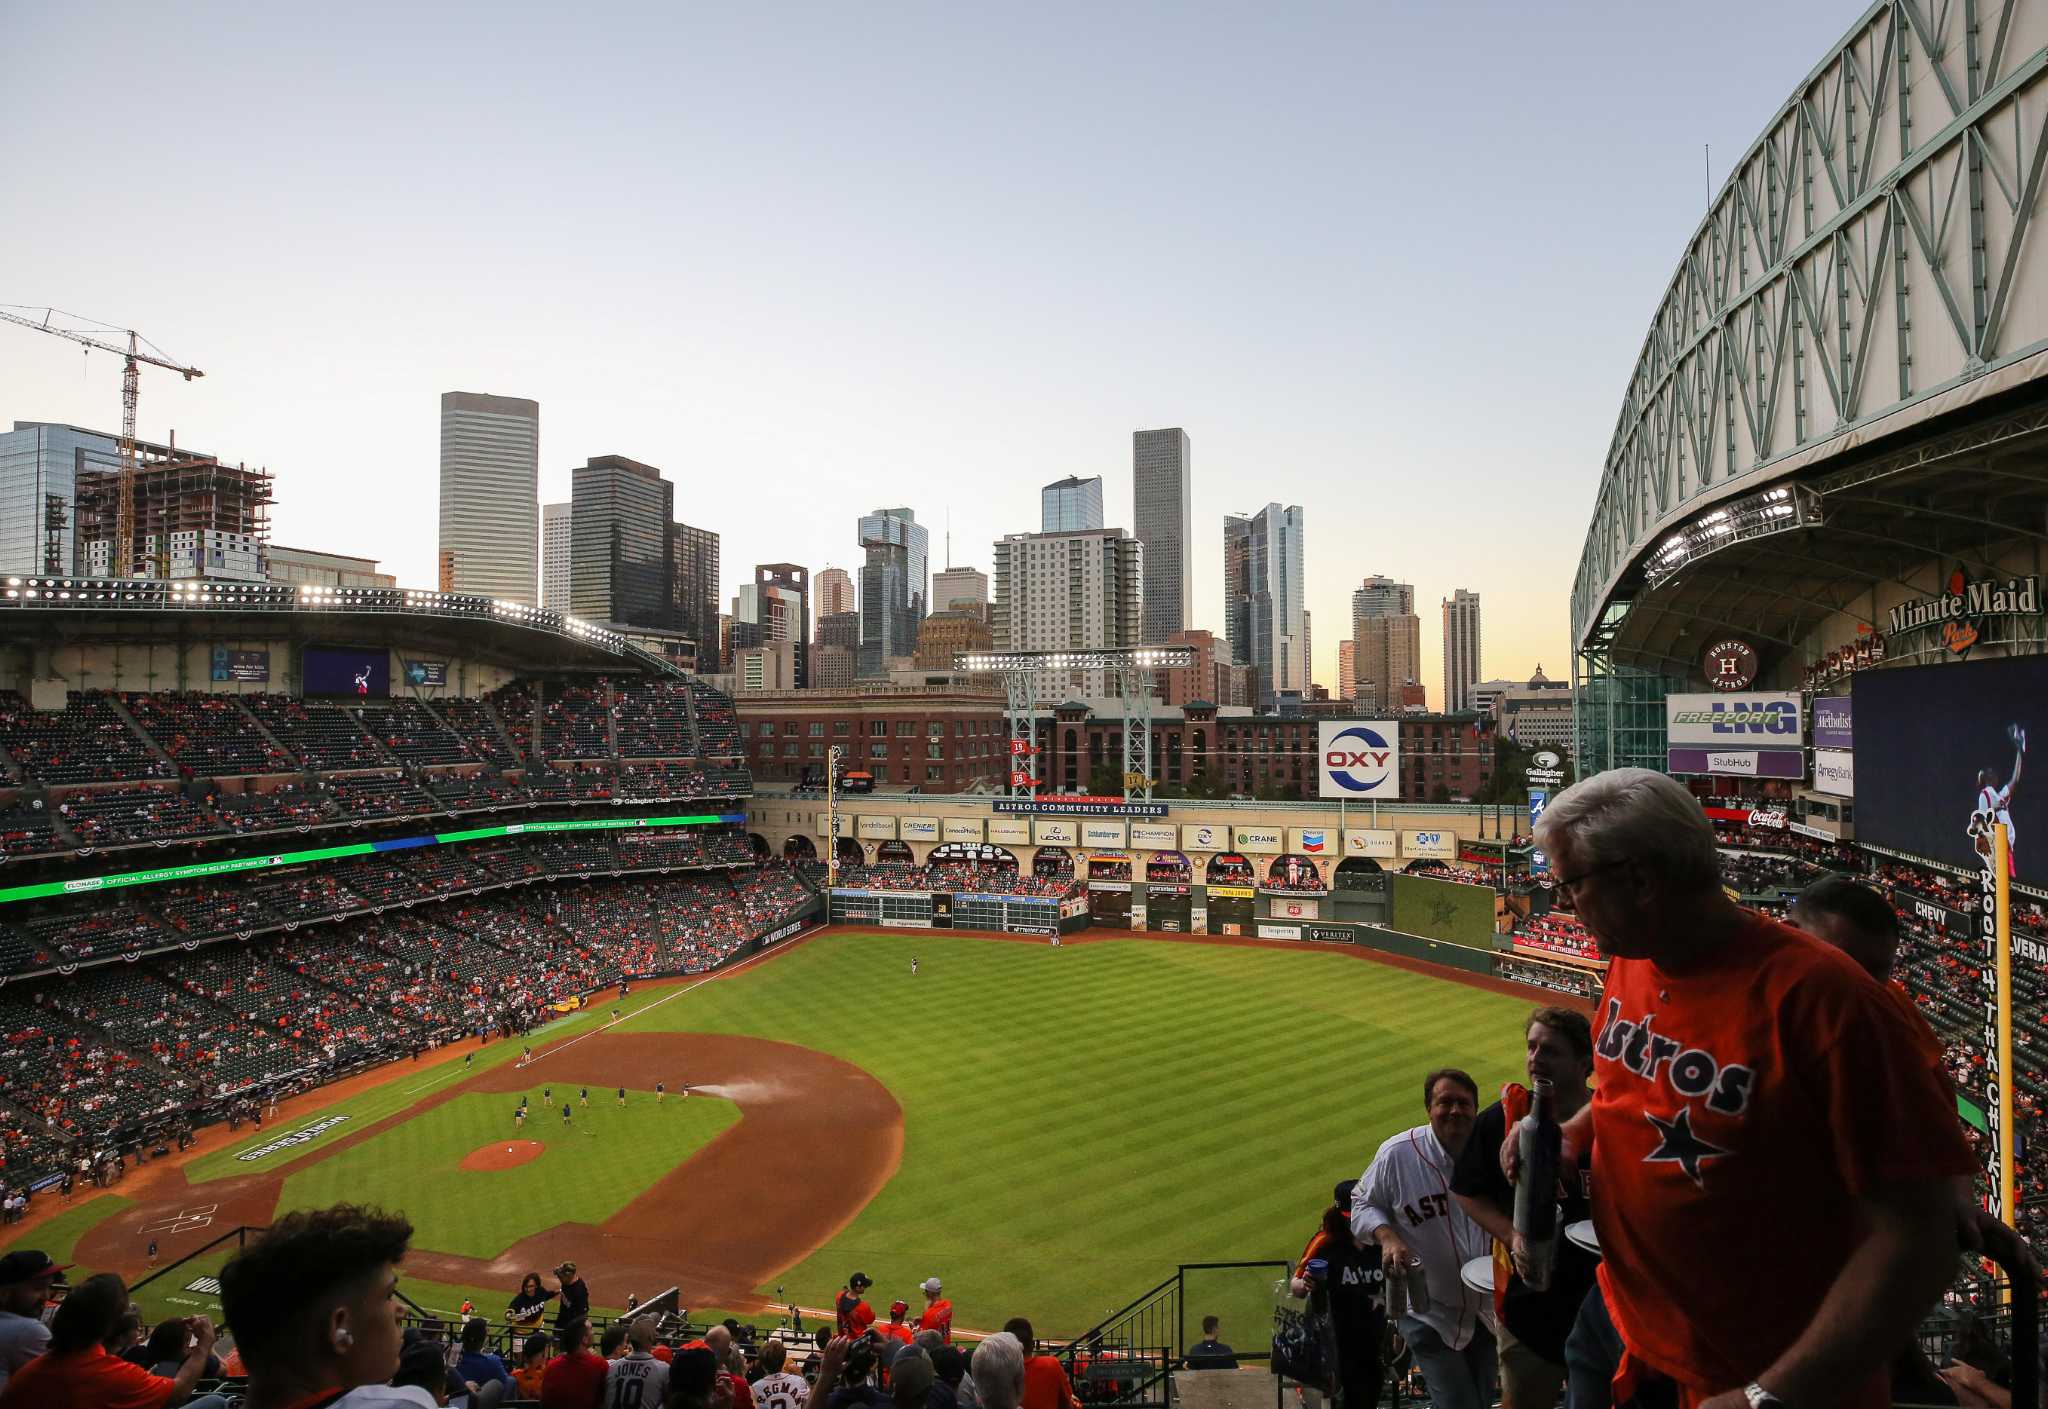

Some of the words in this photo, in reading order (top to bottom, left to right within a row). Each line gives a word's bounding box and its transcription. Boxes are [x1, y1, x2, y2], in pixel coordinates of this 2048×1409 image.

[1889, 591, 1963, 635] Minute
[1967, 577, 2038, 614] Maid
[1942, 621, 1978, 652] Park
[1710, 642, 1750, 657] HOUSTON
[1719, 658, 1738, 675] H
[1712, 675, 1748, 689] ASTROS
[1676, 711, 1774, 724] FREEPORT
[1711, 701, 1798, 735] LNG
[1014, 743, 1024, 751] 19
[1326, 751, 1391, 768] OXY
[1713, 757, 1751, 767] StubHub
[1014, 774, 1024, 783] 05
[1526, 768, 1565, 777] Gallagher
[1817, 762, 1853, 781] AmegyBank
[1041, 804, 1109, 814] COMMUNITY
[1113, 806, 1163, 815] LEADERS
[1040, 834, 1072, 842] LEXUS
[1087, 830, 1121, 841] Schlumberger
[1140, 830, 1176, 838] CHAMPION
[1249, 835, 1278, 844] CRANE
[106, 876, 140, 884] OFFICIAL
[142, 871, 174, 880] ALLERGY
[175, 866, 209, 876] SYMPTOM
[1916, 901, 1946, 926] CHEVY
[1980, 868, 1996, 957] ROOT
[770, 928, 787, 942] WORLD
[787, 921, 801, 935] SERIES
[1983, 1001, 1998, 1072] THA
[1985, 1082, 2001, 1219] CHIKIN
[614, 1362, 651, 1378] JONES
[615, 1379, 643, 1409] 10
